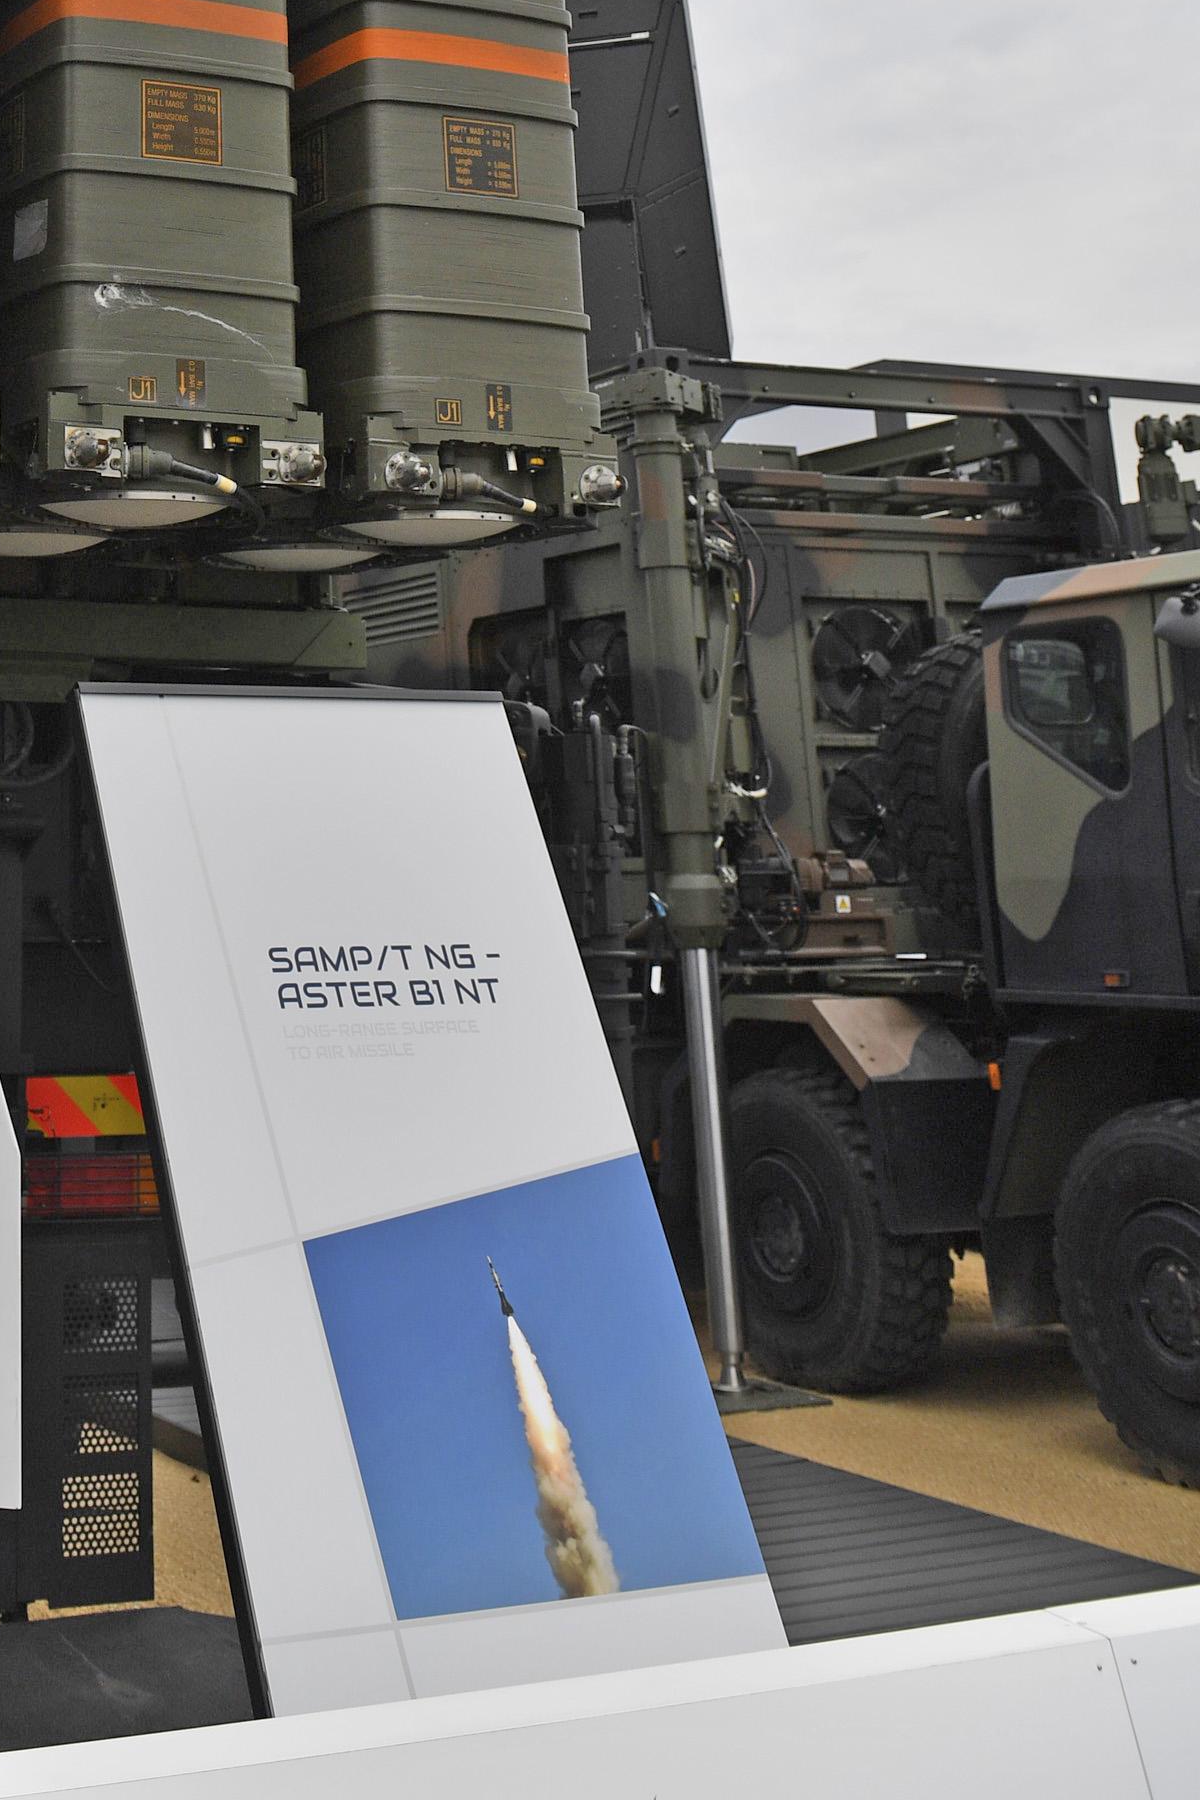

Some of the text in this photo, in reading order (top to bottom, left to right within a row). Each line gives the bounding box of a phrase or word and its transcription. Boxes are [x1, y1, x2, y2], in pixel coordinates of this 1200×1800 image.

[147, 111, 189, 123] DIMENSIONS
[132, 380, 150, 400] J1
[440, 400, 457, 421] J1
[268, 945, 412, 973] SAMP/T
[424, 943, 476, 970] NG
[278, 978, 499, 1009] ASTER B1 NT
[282, 1019, 481, 1040] LONG-RANGE SURFACE
[287, 1041, 416, 1061] TO AIR MISSILE
